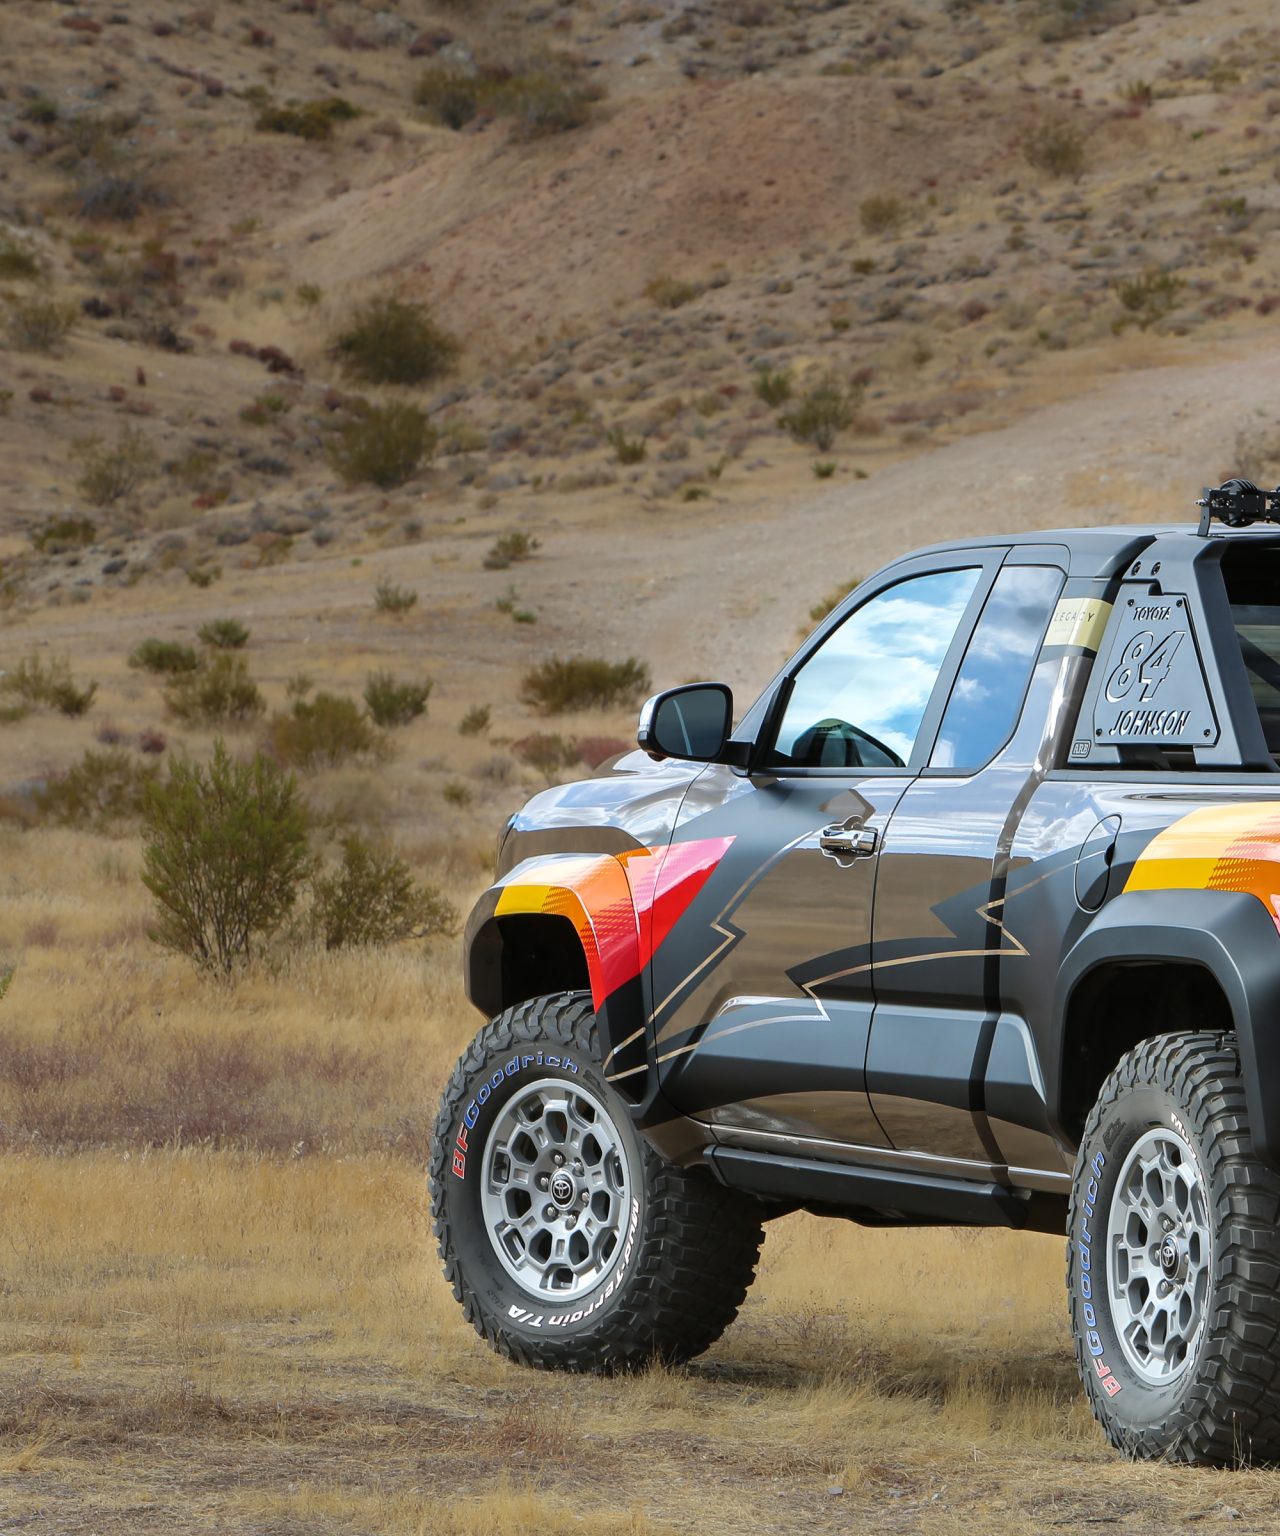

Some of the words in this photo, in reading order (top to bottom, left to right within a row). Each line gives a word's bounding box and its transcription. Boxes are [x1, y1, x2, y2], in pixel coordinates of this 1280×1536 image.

[1053, 610, 1095, 623] LEGACY
[1133, 606, 1172, 621] TOYOTA
[1104, 630, 1187, 704] 84
[1108, 710, 1191, 736] JOHNSON
[1072, 743, 1090, 755] ARB
[451, 1051, 579, 1180] BFGoodrich
[548, 1198, 640, 1328] Mud-Terrain
[1077, 1151, 1123, 1398] BFGoodrich
[507, 1303, 542, 1328] T/A
